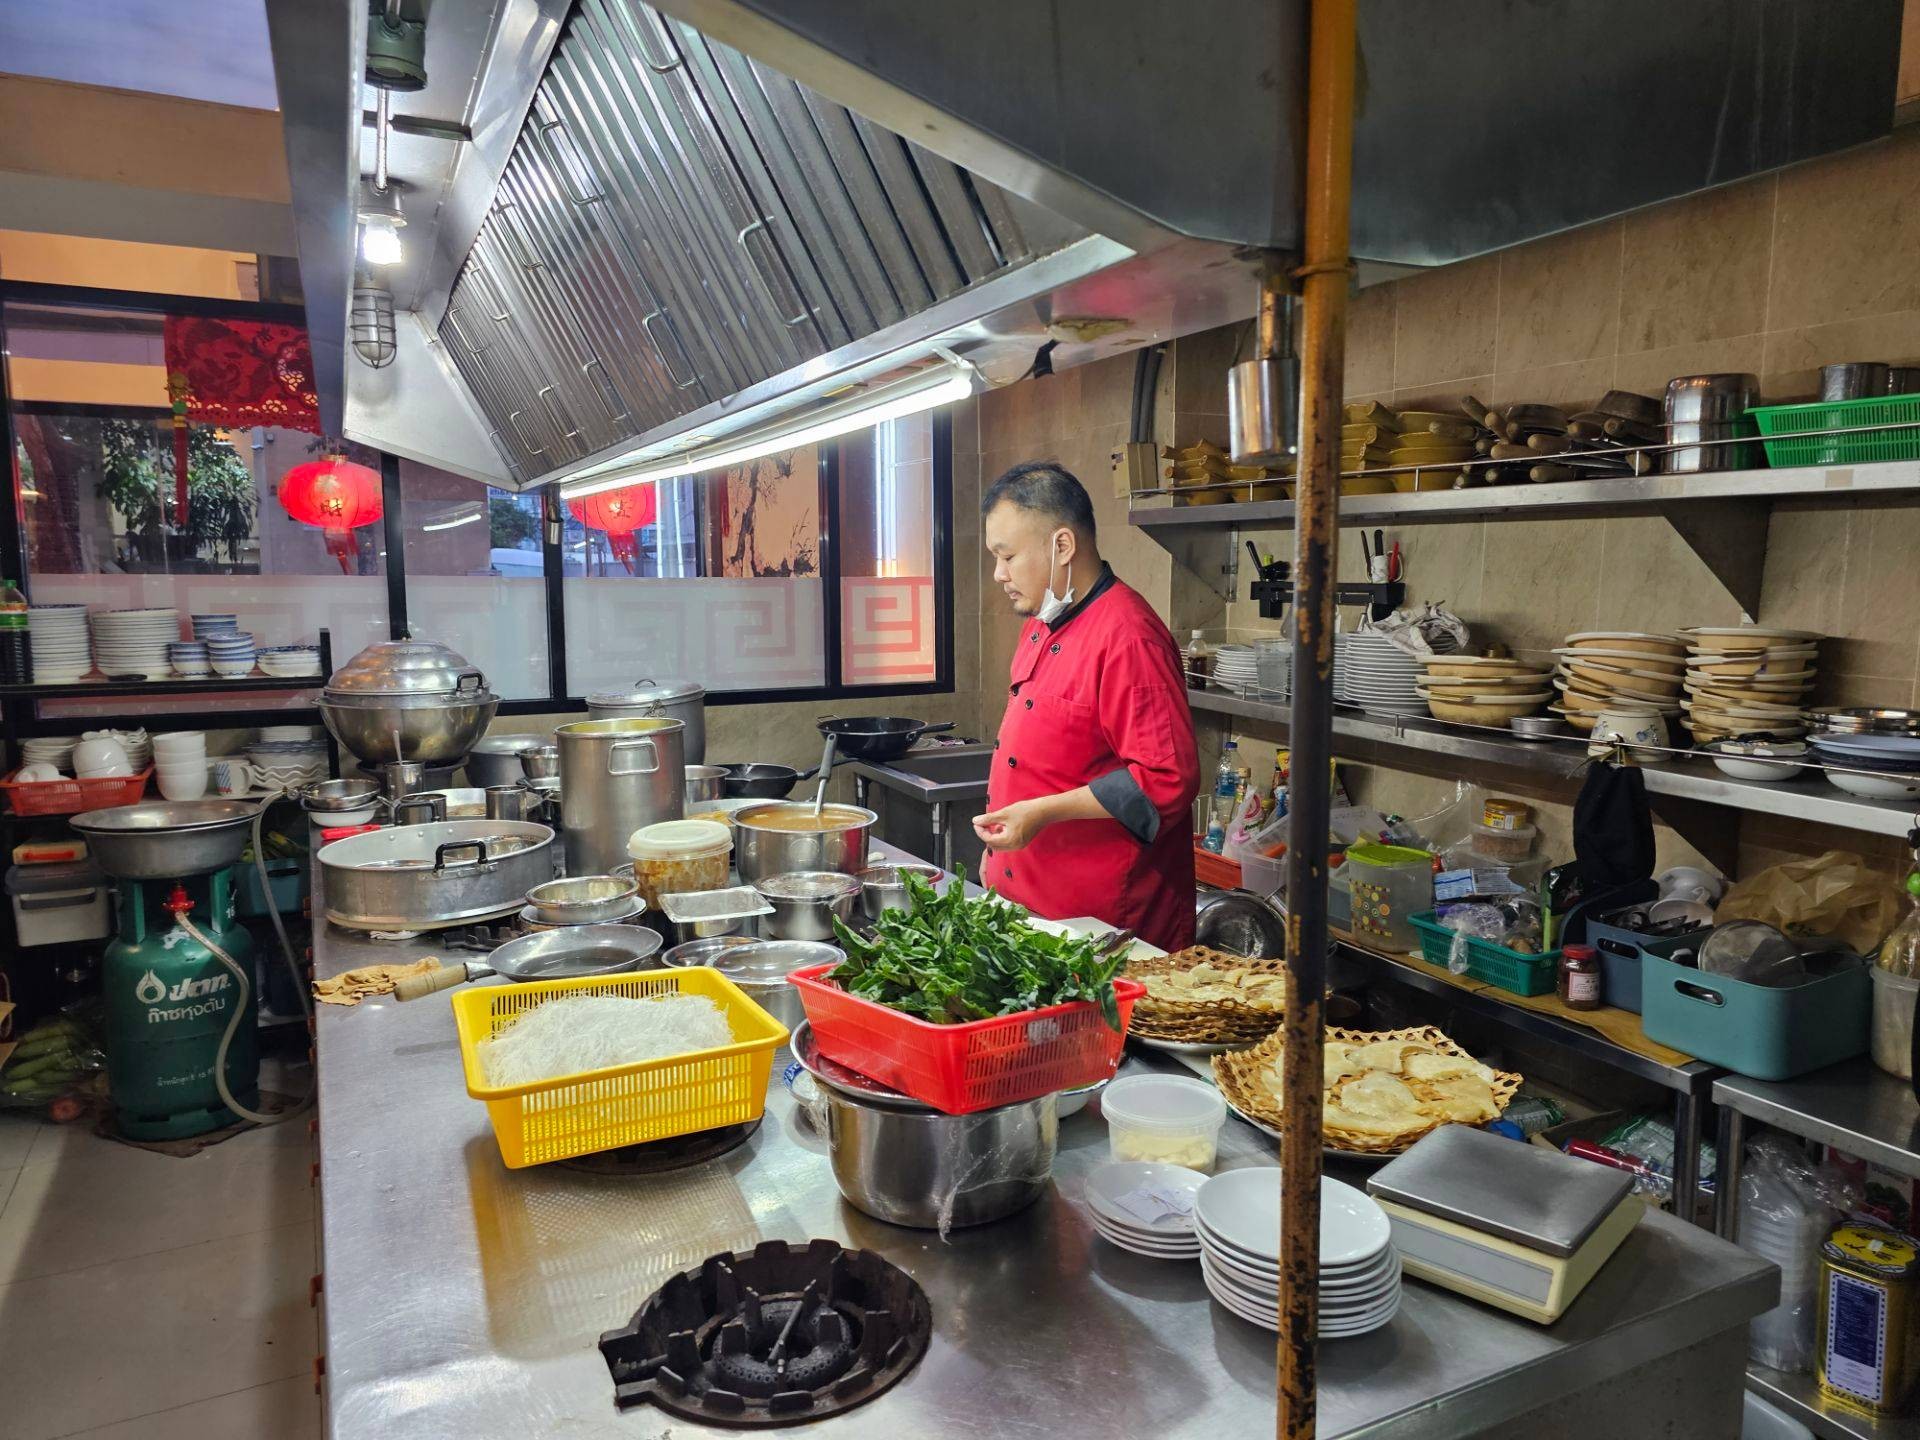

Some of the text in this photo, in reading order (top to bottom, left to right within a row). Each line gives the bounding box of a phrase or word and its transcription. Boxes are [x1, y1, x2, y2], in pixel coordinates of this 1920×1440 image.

[169, 973, 231, 1001] ปตท.
[148, 998, 225, 1024] ก๊าซหุงต้ม
